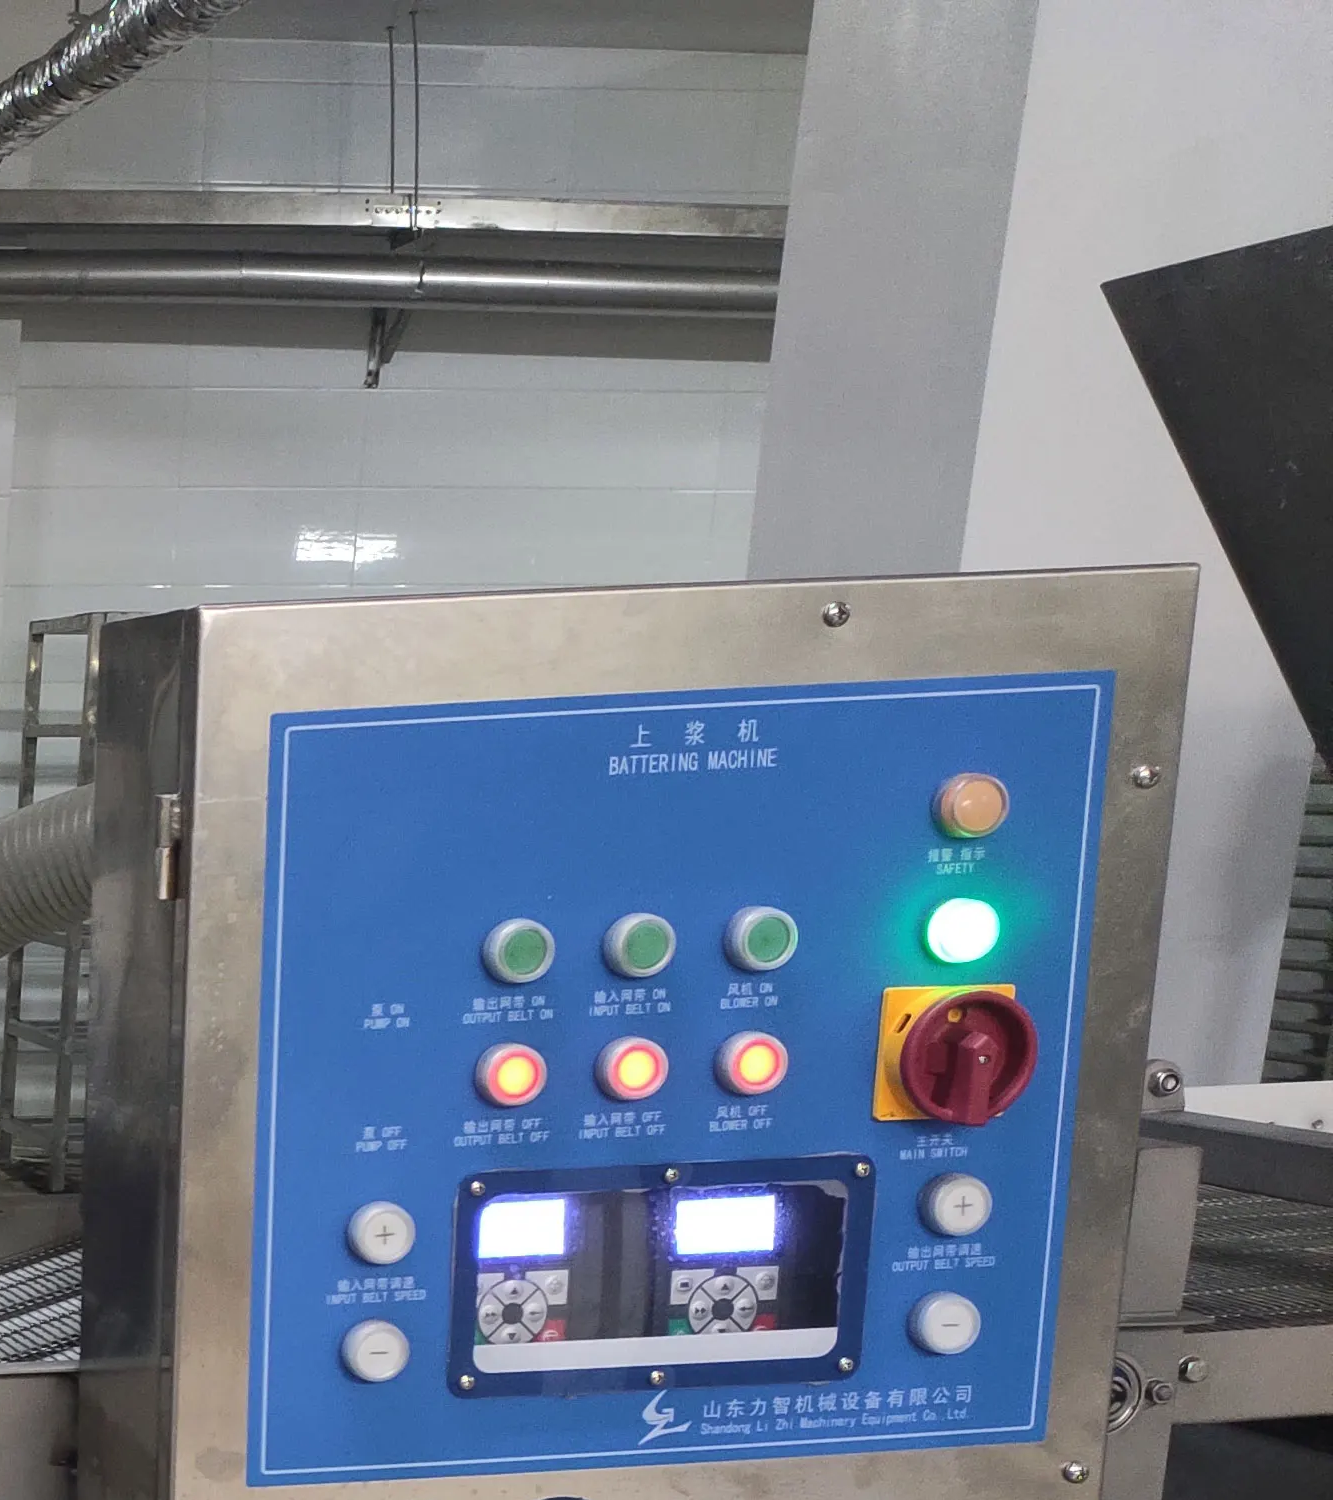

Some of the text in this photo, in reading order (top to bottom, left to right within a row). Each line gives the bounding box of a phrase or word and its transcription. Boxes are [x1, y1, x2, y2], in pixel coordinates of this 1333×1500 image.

[608, 748, 778, 776] BATTERING MACHINE
[935, 863, 976, 875] SAFETY
[652, 989, 666, 1000] ON
[726, 983, 773, 997] 风机 ON
[531, 996, 546, 1007] ON
[720, 996, 778, 1010] BLOWER ON
[390, 1004, 406, 1016] ON
[589, 1002, 672, 1017] INPUT BELT ON
[396, 1017, 411, 1029] ON
[462, 1009, 554, 1025] OUTPUT BELT ON
[641, 1111, 663, 1123] OFF
[747, 1105, 769, 1117] OFF
[521, 1118, 542, 1130] OFF
[709, 1119, 774, 1133] BLOWER OFF
[381, 1126, 403, 1138] OFF
[453, 1131, 551, 1147] OUTPUT BELT OFF
[578, 1125, 667, 1140] INPUT BELT OFF
[387, 1139, 409, 1151] OFF
[899, 1147, 969, 1160] MAIN SWITCH
[891, 1256, 997, 1272] OUTPUT BELT SPEED
[325, 1289, 428, 1305] INPUT BELT SPEED
[702, 1384, 973, 1419] 山东力智机械设备有限公司
[700, 1422, 751, 1436] Shandong
[756, 1420, 769, 1432] Li
[775, 1418, 794, 1431] Zhi
[799, 1416, 857, 1429] Machinery
[861, 1411, 918, 1427] Equipment
